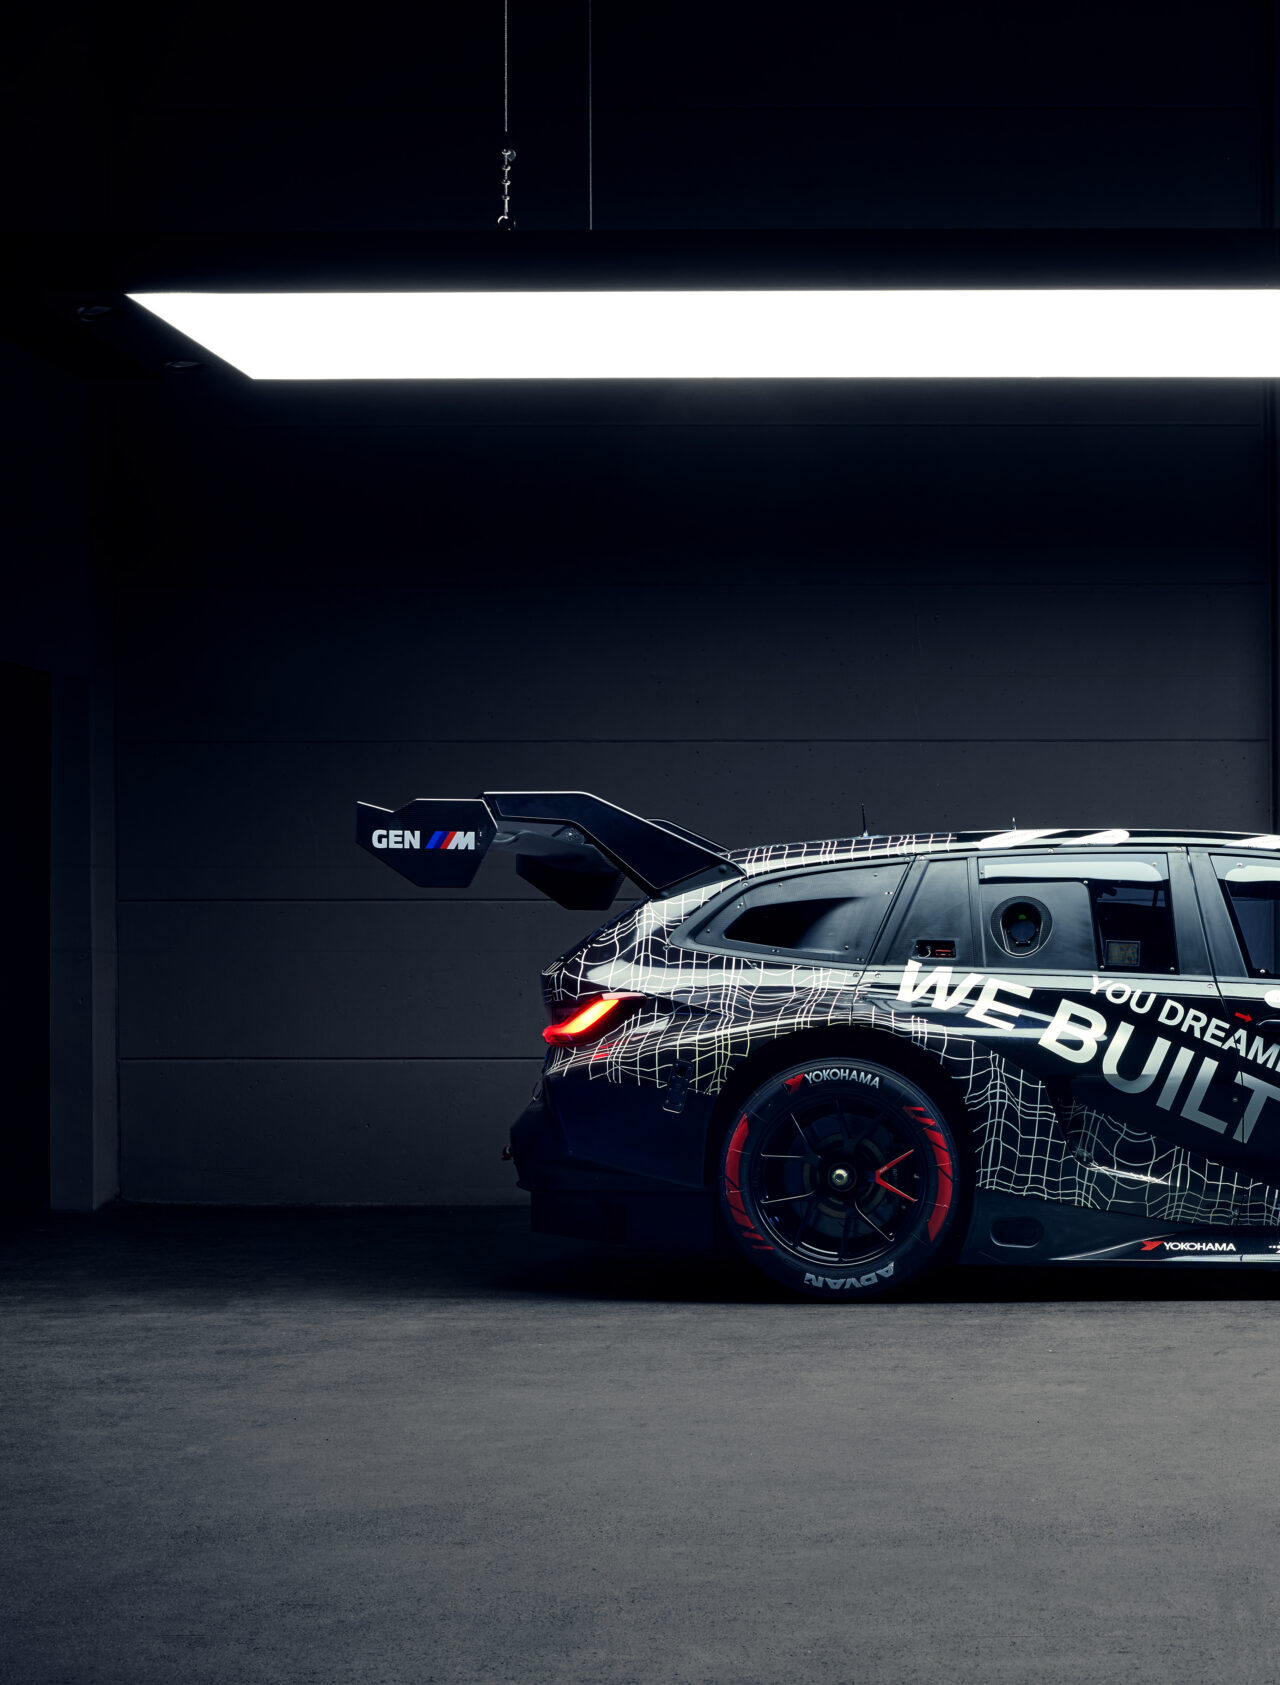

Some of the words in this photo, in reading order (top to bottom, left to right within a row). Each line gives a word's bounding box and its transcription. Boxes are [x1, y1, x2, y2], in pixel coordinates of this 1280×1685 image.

[372, 829, 420, 849] GEN
[896, 959, 1033, 1031] WE
[1089, 975, 1156, 1014] YOU
[804, 1069, 880, 1089] YOKOHAMA
[1164, 1242, 1236, 1251] YOKOHAMA
[804, 1262, 895, 1290] ADVAN
